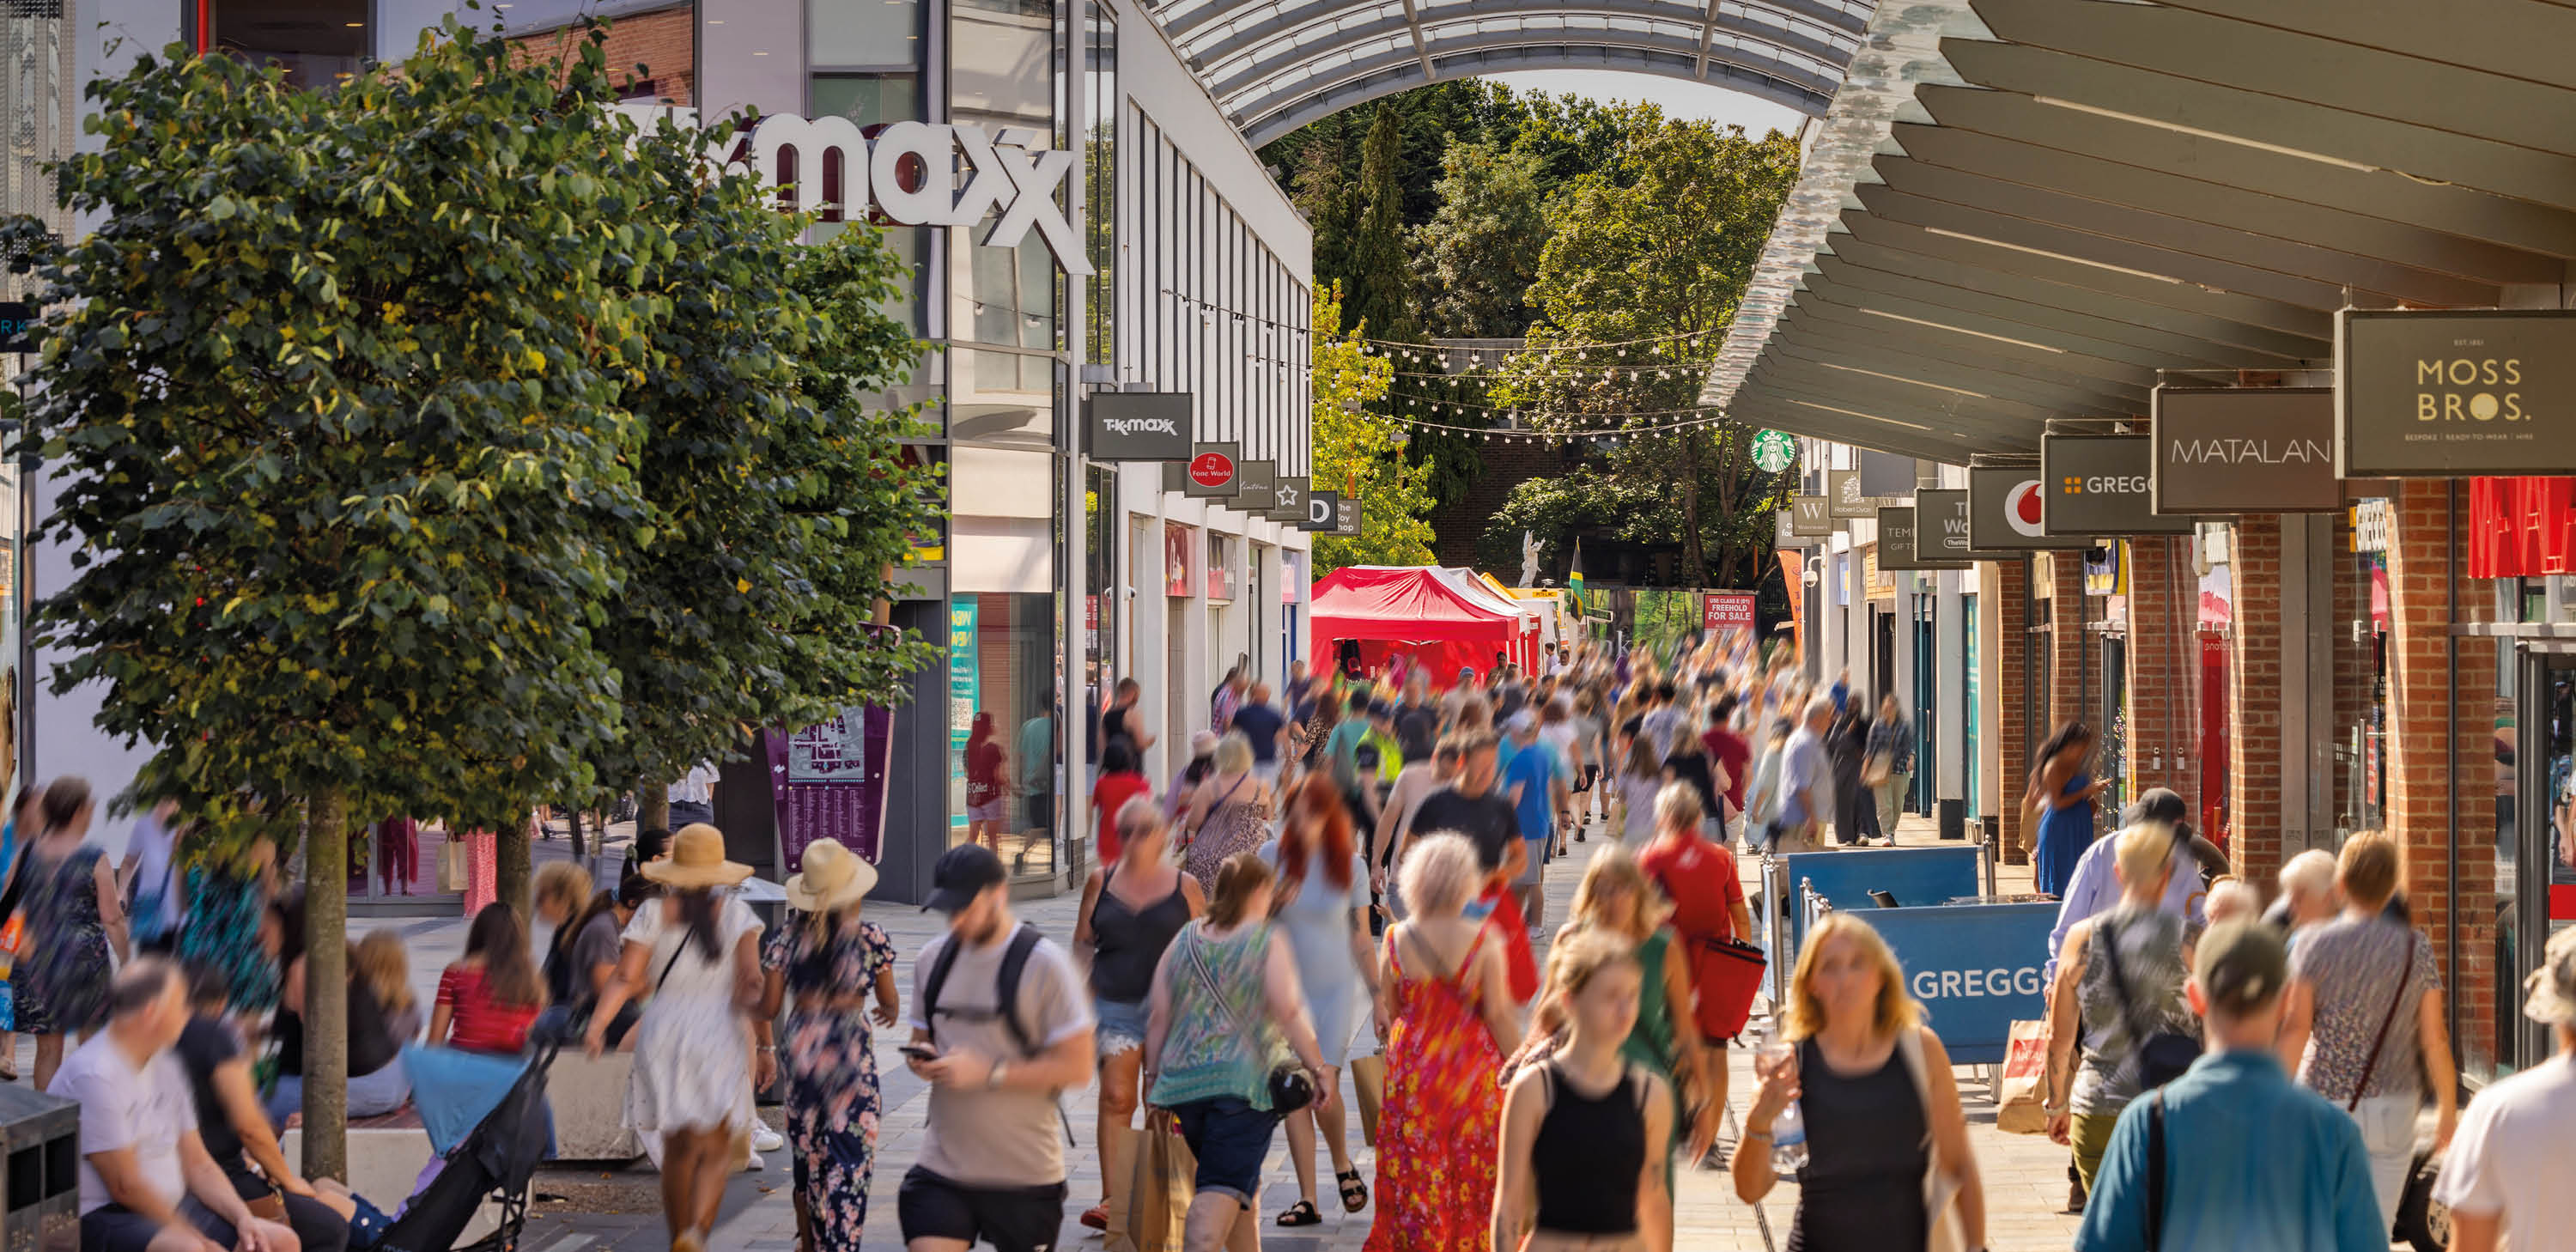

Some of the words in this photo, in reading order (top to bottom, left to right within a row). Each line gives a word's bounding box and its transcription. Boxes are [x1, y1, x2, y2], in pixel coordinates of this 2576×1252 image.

[2418, 359, 2521, 386] MOSS
[2418, 392, 2531, 421] BROS.
[2172, 439, 2330, 464] MATALAN
[1338, 503, 1352, 512] he
[1801, 502, 1823, 520] W
[1338, 514, 1351, 524] oy
[1887, 527, 1915, 538] TEM
[1708, 611, 1726, 620] FOR
[1728, 611, 1752, 621] SALE
